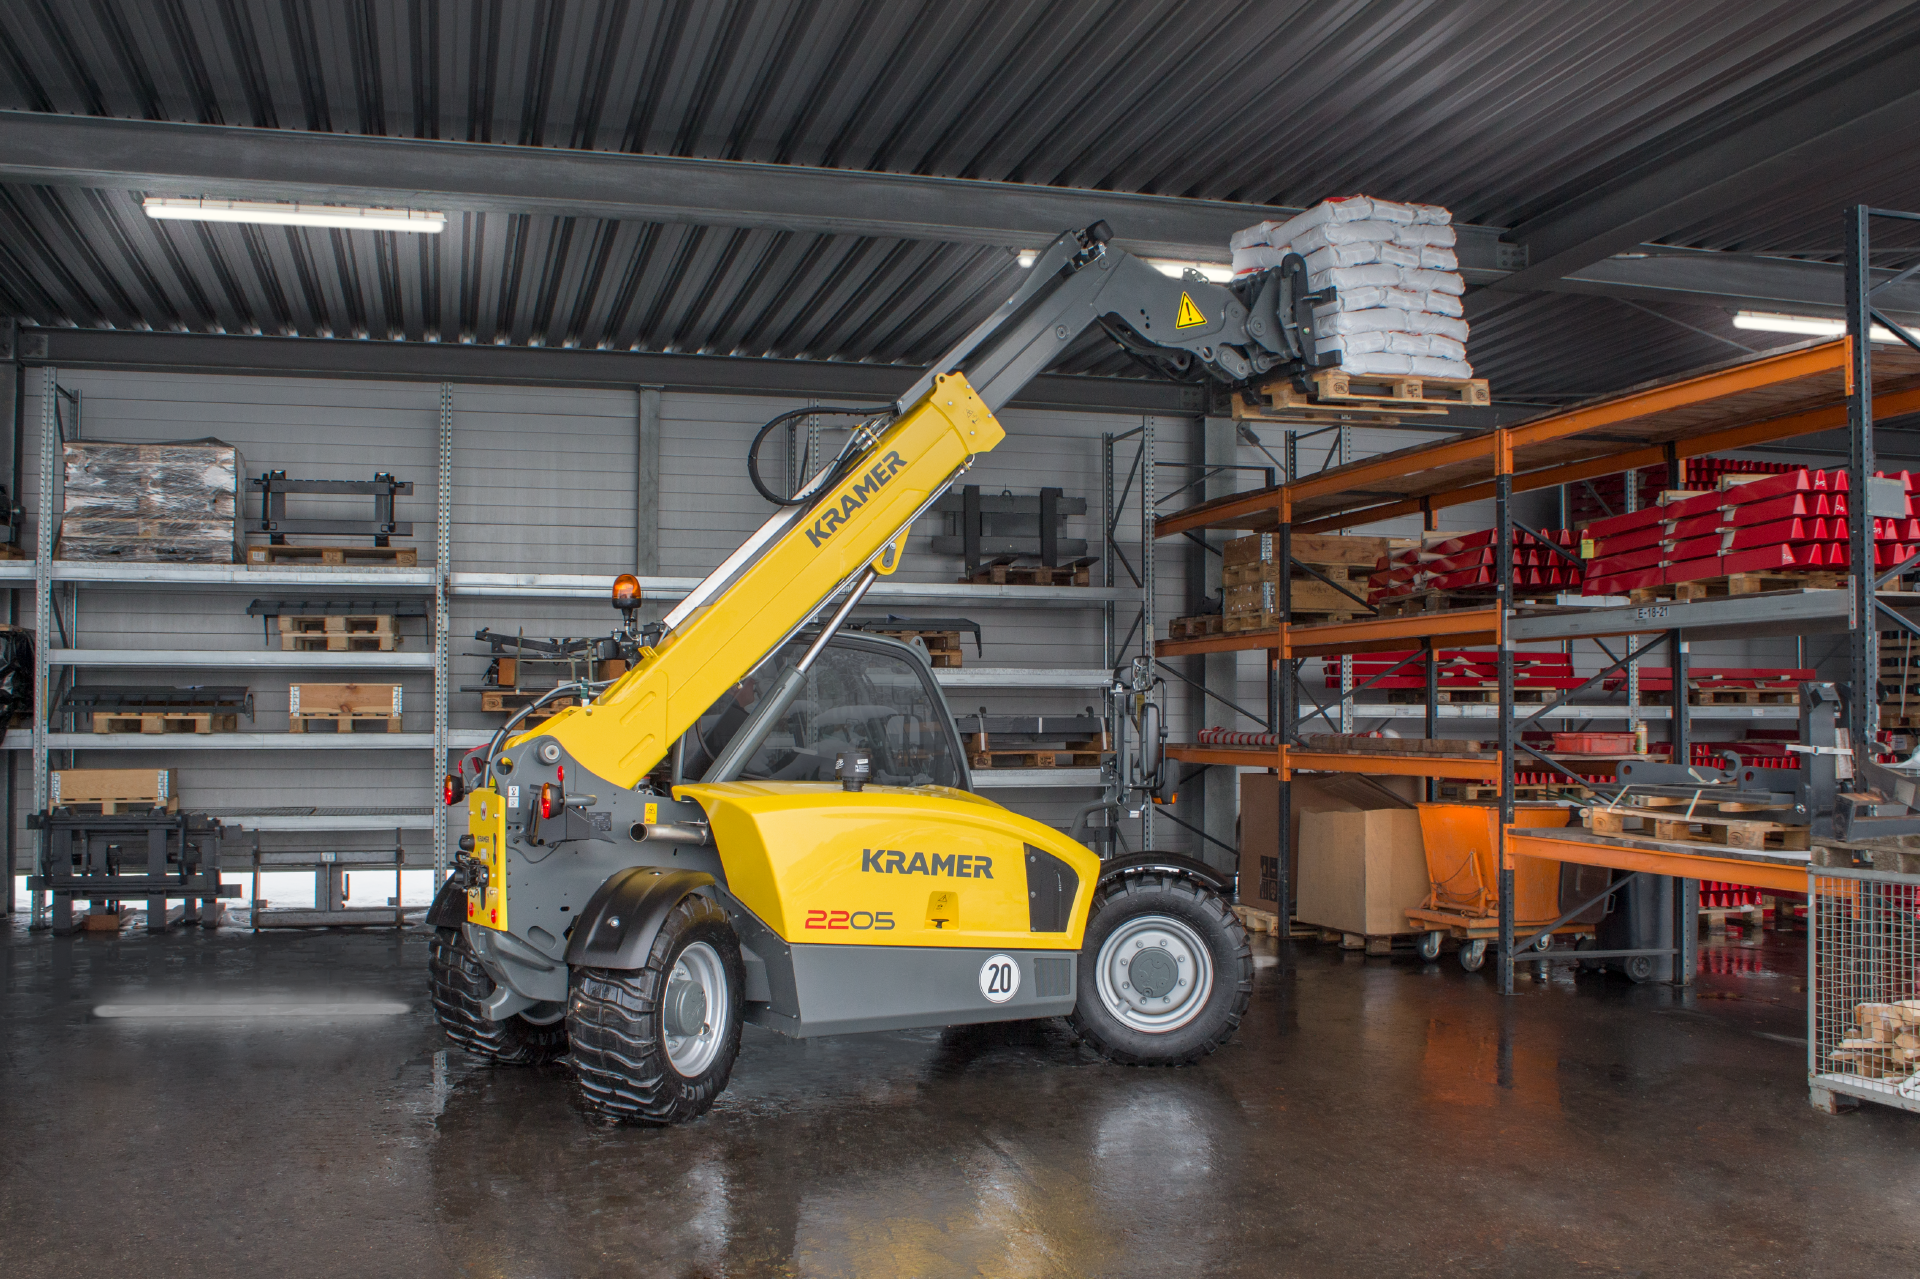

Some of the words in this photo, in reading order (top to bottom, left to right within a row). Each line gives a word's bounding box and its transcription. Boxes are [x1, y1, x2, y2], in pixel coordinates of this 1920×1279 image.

[804, 450, 908, 549] KRAMER
[1637, 607, 1669, 619] E-18-21
[861, 848, 994, 879] KRAMER
[805, 909, 896, 930] 2205
[987, 963, 1012, 994] 20
